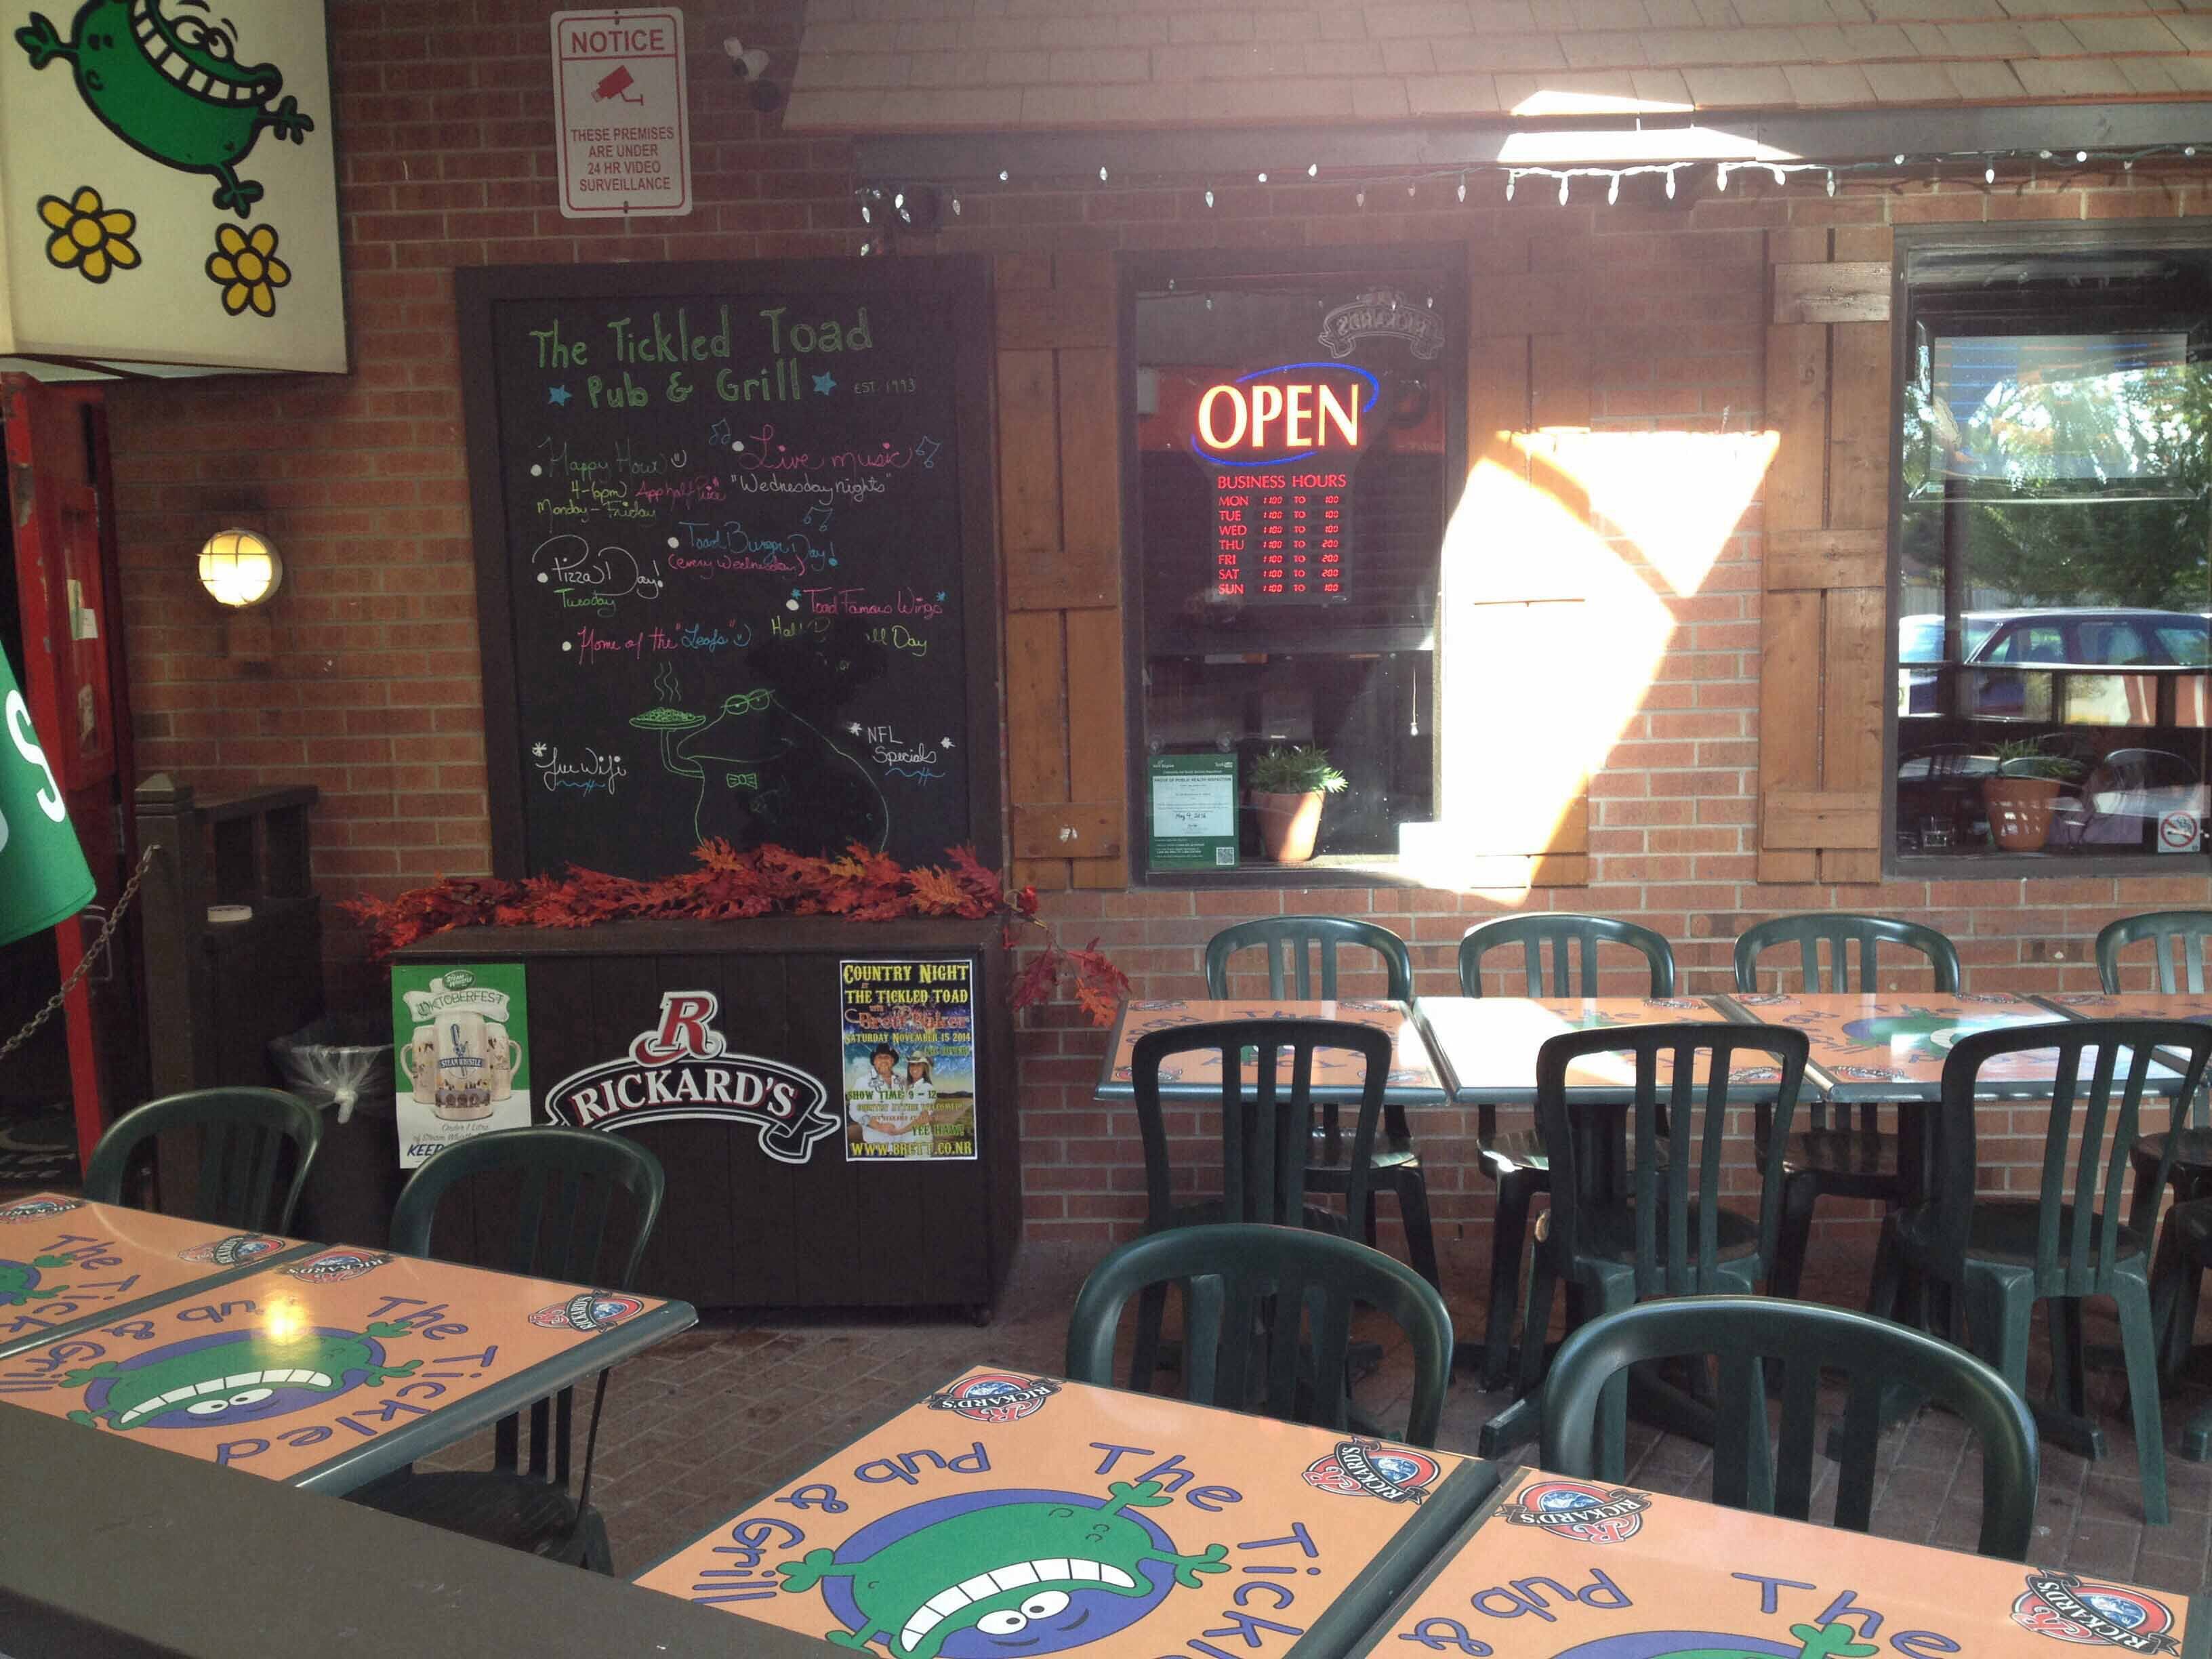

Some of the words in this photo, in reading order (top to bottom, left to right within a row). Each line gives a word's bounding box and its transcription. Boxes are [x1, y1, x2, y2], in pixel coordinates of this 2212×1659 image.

[572, 28, 664, 53] NOTICE
[571, 129, 610, 142] THESE
[613, 127, 674, 140] PREMISES
[589, 146, 613, 157] ARE
[617, 144, 658, 157] UNDER
[588, 162, 600, 174] 24
[605, 162, 621, 174] HR
[625, 161, 661, 173] VIDEO
[579, 177, 670, 192] SURVEILLANCE
[529, 319, 588, 369] The
[609, 304, 731, 363] Tickled
[760, 307, 873, 353] Toad
[588, 371, 649, 408] Pub
[666, 372, 693, 402] &
[716, 358, 801, 402] Grill
[885, 378, 917, 394] 1993
[1198, 383, 1359, 449] OPEN
[537, 436, 609, 483] Happy
[738, 424, 824, 470] Live
[832, 442, 913, 470] music
[1218, 476, 1285, 489] BUSINESS
[1292, 474, 1347, 488] HOURS
[537, 498, 590, 533] Monday
[602, 500, 656, 526] Friday
[1218, 495, 1249, 506] MON
[1294, 495, 1306, 504] TO
[1218, 510, 1241, 520] TUE
[1294, 510, 1306, 518] TO
[1218, 525, 1247, 535] WED
[1294, 525, 1306, 533] TO
[1218, 540, 1244, 550] THU
[1294, 539, 1306, 548] TO
[678, 521, 726, 549] Toad
[787, 534, 838, 572] Day!
[1218, 554, 1236, 565] FRI
[1294, 555, 1306, 563] TO
[532, 534, 605, 583] Pizza
[598, 546, 663, 599] Day!
[1218, 569, 1240, 579] SAT
[1294, 569, 1306, 578] TO
[554, 588, 617, 617] Tuesday
[802, 587, 839, 615] Toad
[838, 588, 893, 614] Famous
[899, 587, 943, 619] Wings
[1218, 583, 1244, 594] SUN
[1294, 583, 1306, 592] TO
[577, 626, 621, 663] Home
[625, 632, 644, 660] of
[649, 627, 677, 651] the
[891, 625, 927, 657] Day
[867, 726, 903, 744] NFL
[535, 747, 579, 792] Free
[872, 742, 937, 766] Specials
[843, 964, 912, 985] COUNTRY
[919, 964, 968, 983] NIGHT
[418, 991, 503, 1016] OKTOBERFEST
[845, 990, 872, 1004] THE
[876, 989, 929, 1004] TICKLED
[933, 989, 968, 1003] TOAD
[635, 996, 718, 1064] R
[844, 1033, 889, 1044] SATURDAY
[893, 1032, 938, 1044] NOVEMBER
[941, 1033, 949, 1042] 15
[953, 1032, 970, 1042] 2014
[571, 1068, 797, 1128] RICKARD'S
[848, 1090, 874, 1100] SHOW
[908, 1090, 914, 1100] 9
[928, 1090, 937, 1099] 12
[912, 1125, 930, 1136] YEE
[39, 1235, 122, 1270] The
[368, 1296, 469, 1340] The
[571, 1296, 597, 1330] RICKARD'S
[102, 1320, 155, 1340] &
[0, 1341, 106, 1393] Grill
[217, 1345, 497, 1465] Tickled
[941, 1386, 1052, 1411] RICKARD'S
[854, 1441, 991, 1485] Pub
[1089, 1441, 1243, 1512] The
[1343, 1446, 1401, 1500] RICKARD'S
[775, 1483, 849, 1514] &
[1520, 1498, 1643, 1525] RICKARD'S
[692, 1517, 806, 1603] Grill
[1471, 1568, 1633, 1622] Pub
[1732, 1572, 1962, 1659] The
[2035, 1580, 2142, 1650] RICKARD'S
[1398, 1617, 1494, 1658] &
